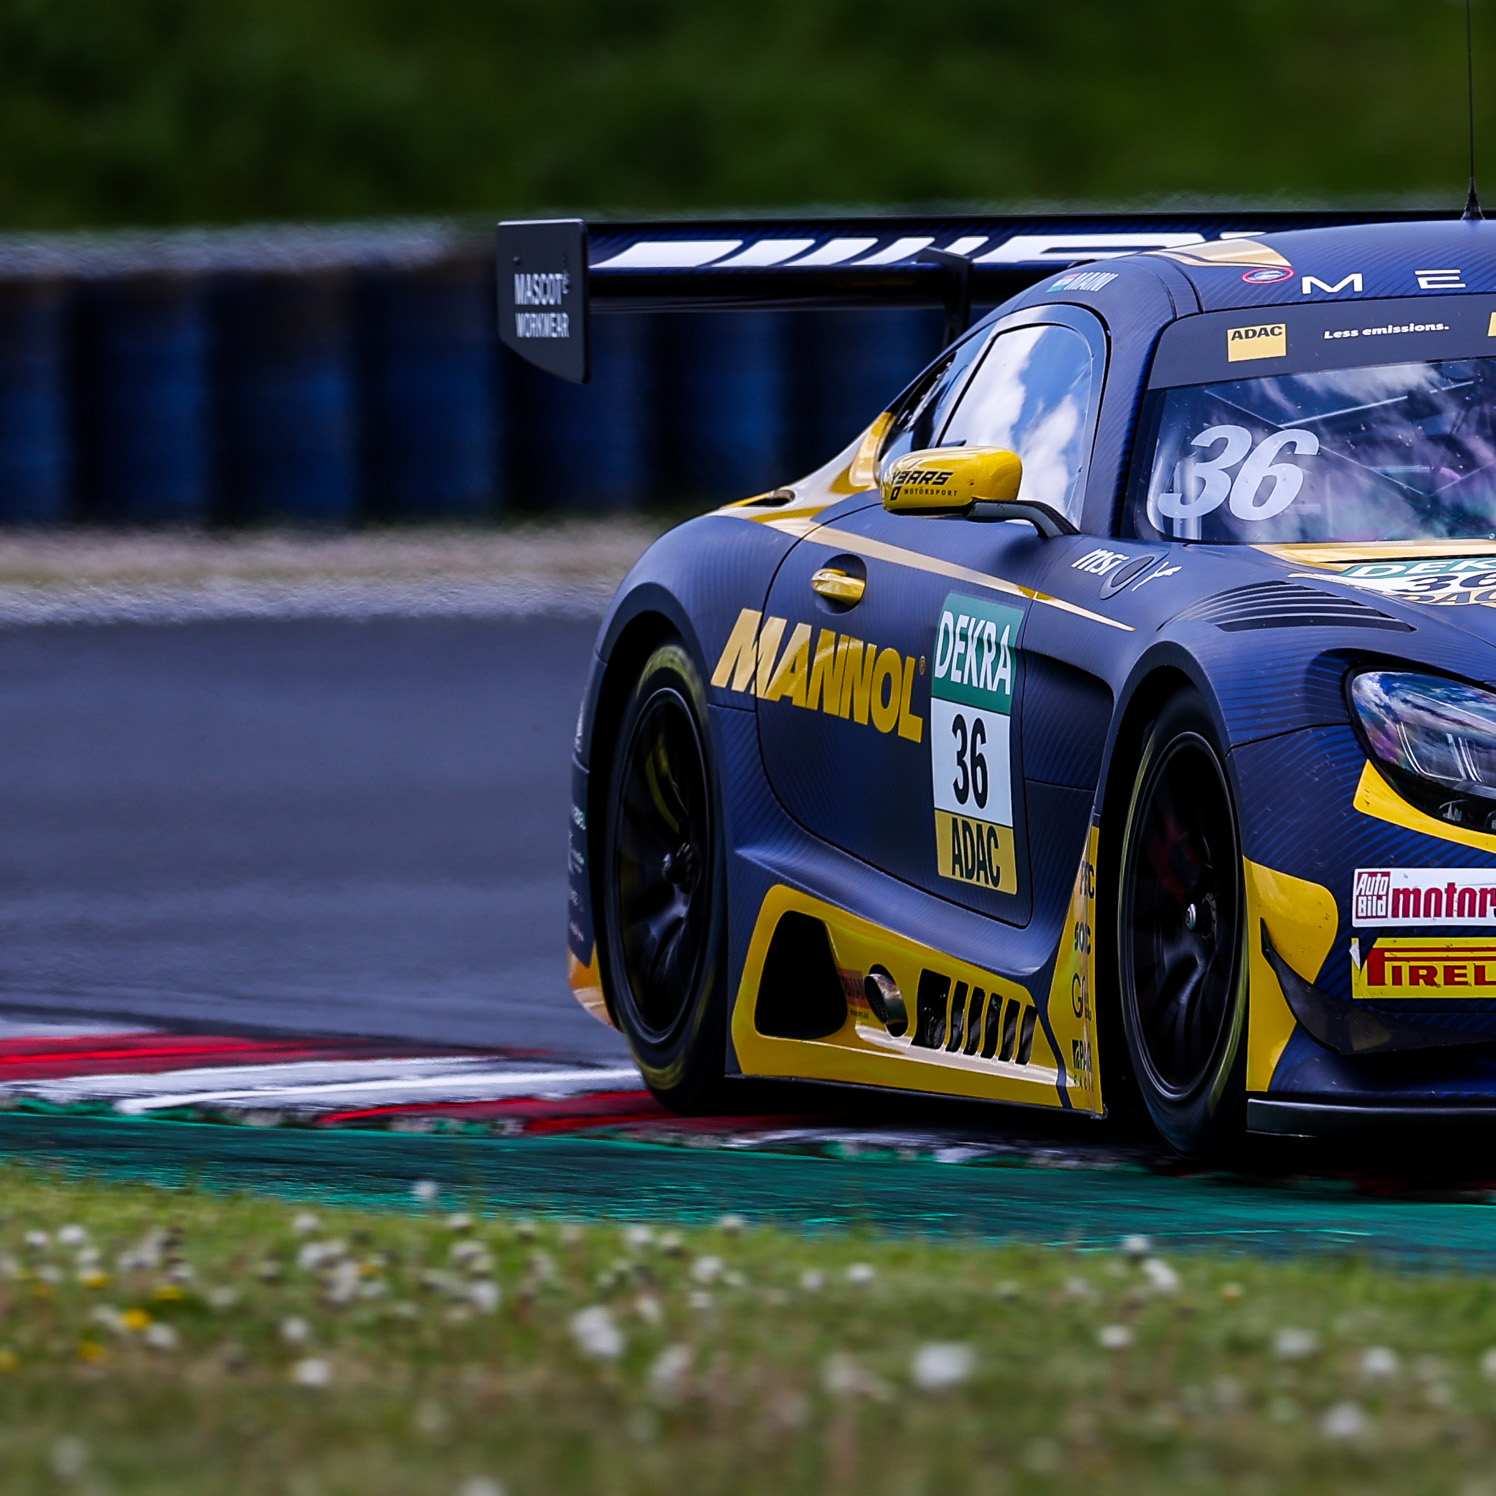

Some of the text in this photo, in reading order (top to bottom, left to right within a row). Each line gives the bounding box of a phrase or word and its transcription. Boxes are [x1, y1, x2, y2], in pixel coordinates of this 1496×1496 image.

[514, 273, 562, 305] MASCOT
[515, 312, 569, 338] WORKWEAR
[1230, 325, 1284, 342] ADAC
[1323, 322, 1451, 340] Less emissions.
[1156, 424, 1320, 521] 36
[934, 610, 1012, 695] DEKRA
[711, 608, 924, 744] MANNOL
[951, 713, 988, 810] 36
[951, 816, 1001, 889] ADAC
[1356, 872, 1389, 896] Auto
[1357, 896, 1387, 917] Bild
